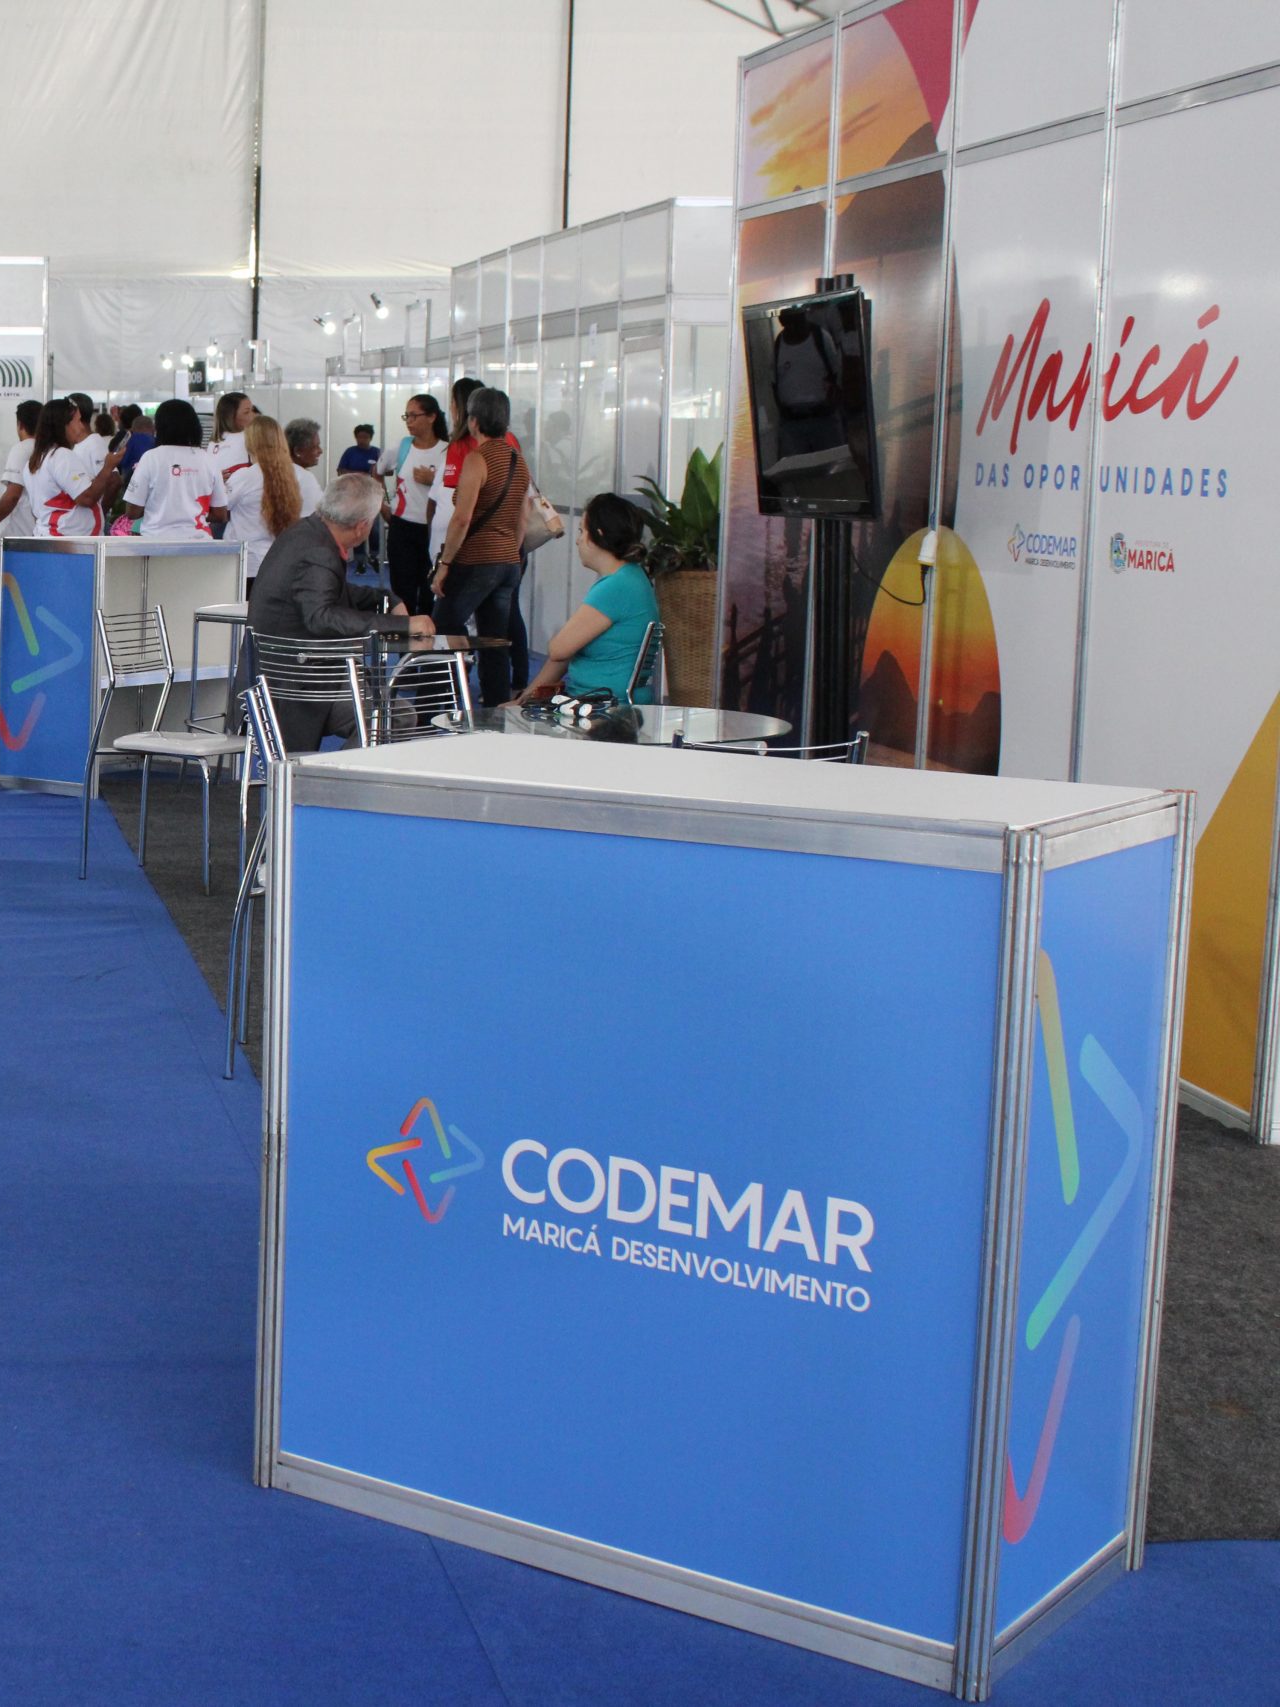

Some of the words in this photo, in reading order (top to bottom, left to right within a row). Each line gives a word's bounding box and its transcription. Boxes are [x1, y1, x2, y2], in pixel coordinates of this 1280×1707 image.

[976, 298, 1239, 455] Maricá
[975, 462, 1009, 488] DAS
[1023, 463, 1228, 498] OPORUNIDADES
[1025, 533, 1077, 558] CODEMAR
[1127, 548, 1175, 573] MARICÁ
[502, 1139, 874, 1272] CODEMAR
[502, 1213, 602, 1257] MARICÁ
[611, 1236, 870, 1313] DESENVOLVIMENTO
